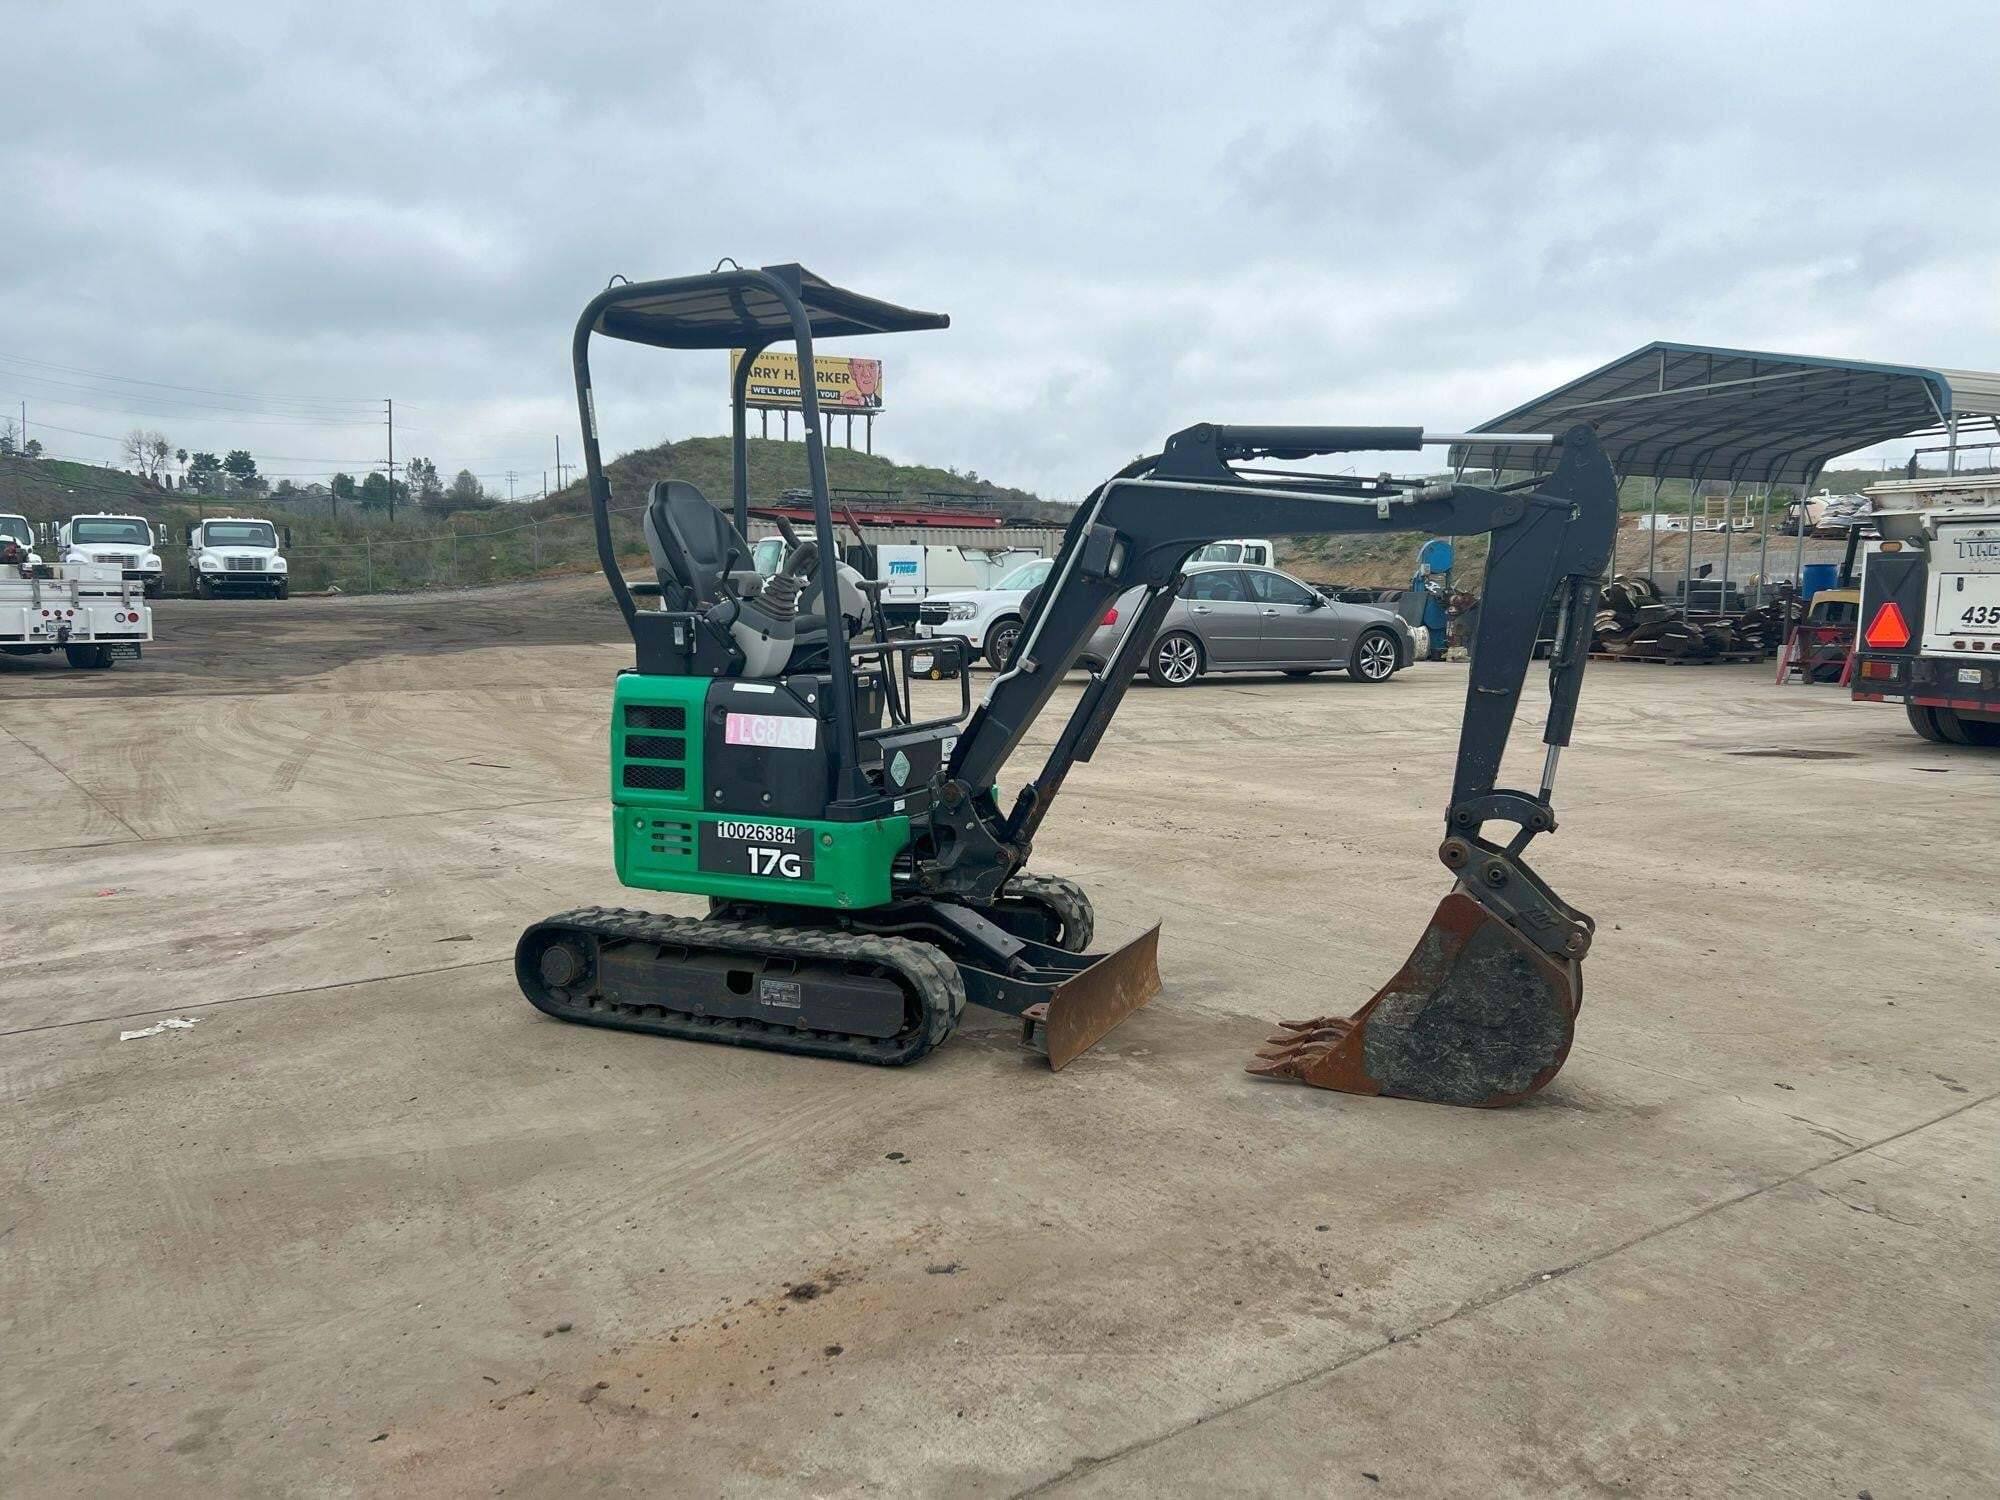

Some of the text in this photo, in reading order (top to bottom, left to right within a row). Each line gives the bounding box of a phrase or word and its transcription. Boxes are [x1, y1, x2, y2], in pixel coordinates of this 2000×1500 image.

[816, 371, 850, 385] RKER
[753, 386, 777, 395] WE'LL
[778, 388, 801, 397] FIGHT
[820, 391, 839, 399] YOU!
[1961, 606, 2000, 625] 435
[718, 821, 795, 843] 10026384
[747, 846, 802, 879] 17G
